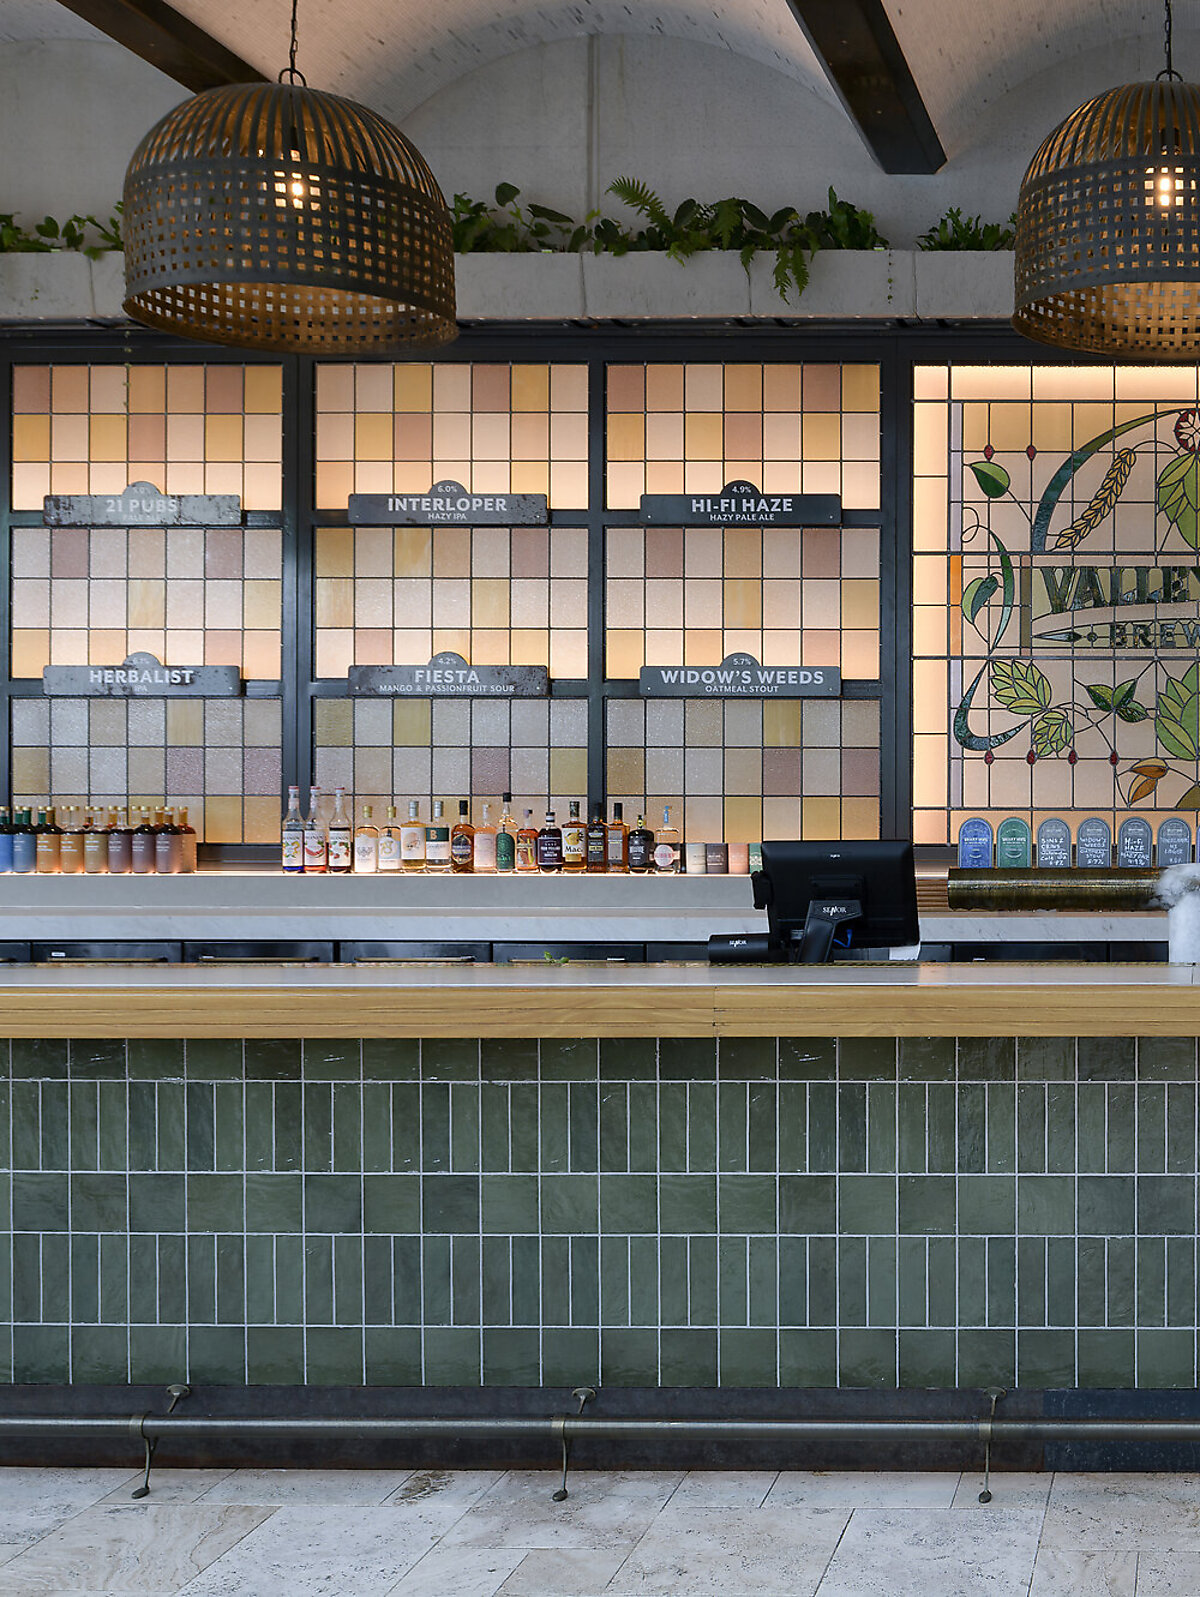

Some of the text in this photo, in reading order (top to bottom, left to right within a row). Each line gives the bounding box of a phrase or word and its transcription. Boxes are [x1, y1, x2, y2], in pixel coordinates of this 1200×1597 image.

[106, 499, 179, 513] 21 PUBS
[388, 498, 508, 512] INTERLOPER
[691, 499, 794, 513] HI-FI HAZE
[733, 658, 752, 666] 5.7%
[89, 670, 194, 684] HERBALIST
[414, 670, 480, 684] FIESTA
[757, 671, 824, 685] WEEDS
[379, 685, 413, 693] MANGO
[425, 685, 487, 693] PASSIONFRUIT
[490, 685, 515, 693] SOUR
[430, 829, 438, 840] B
